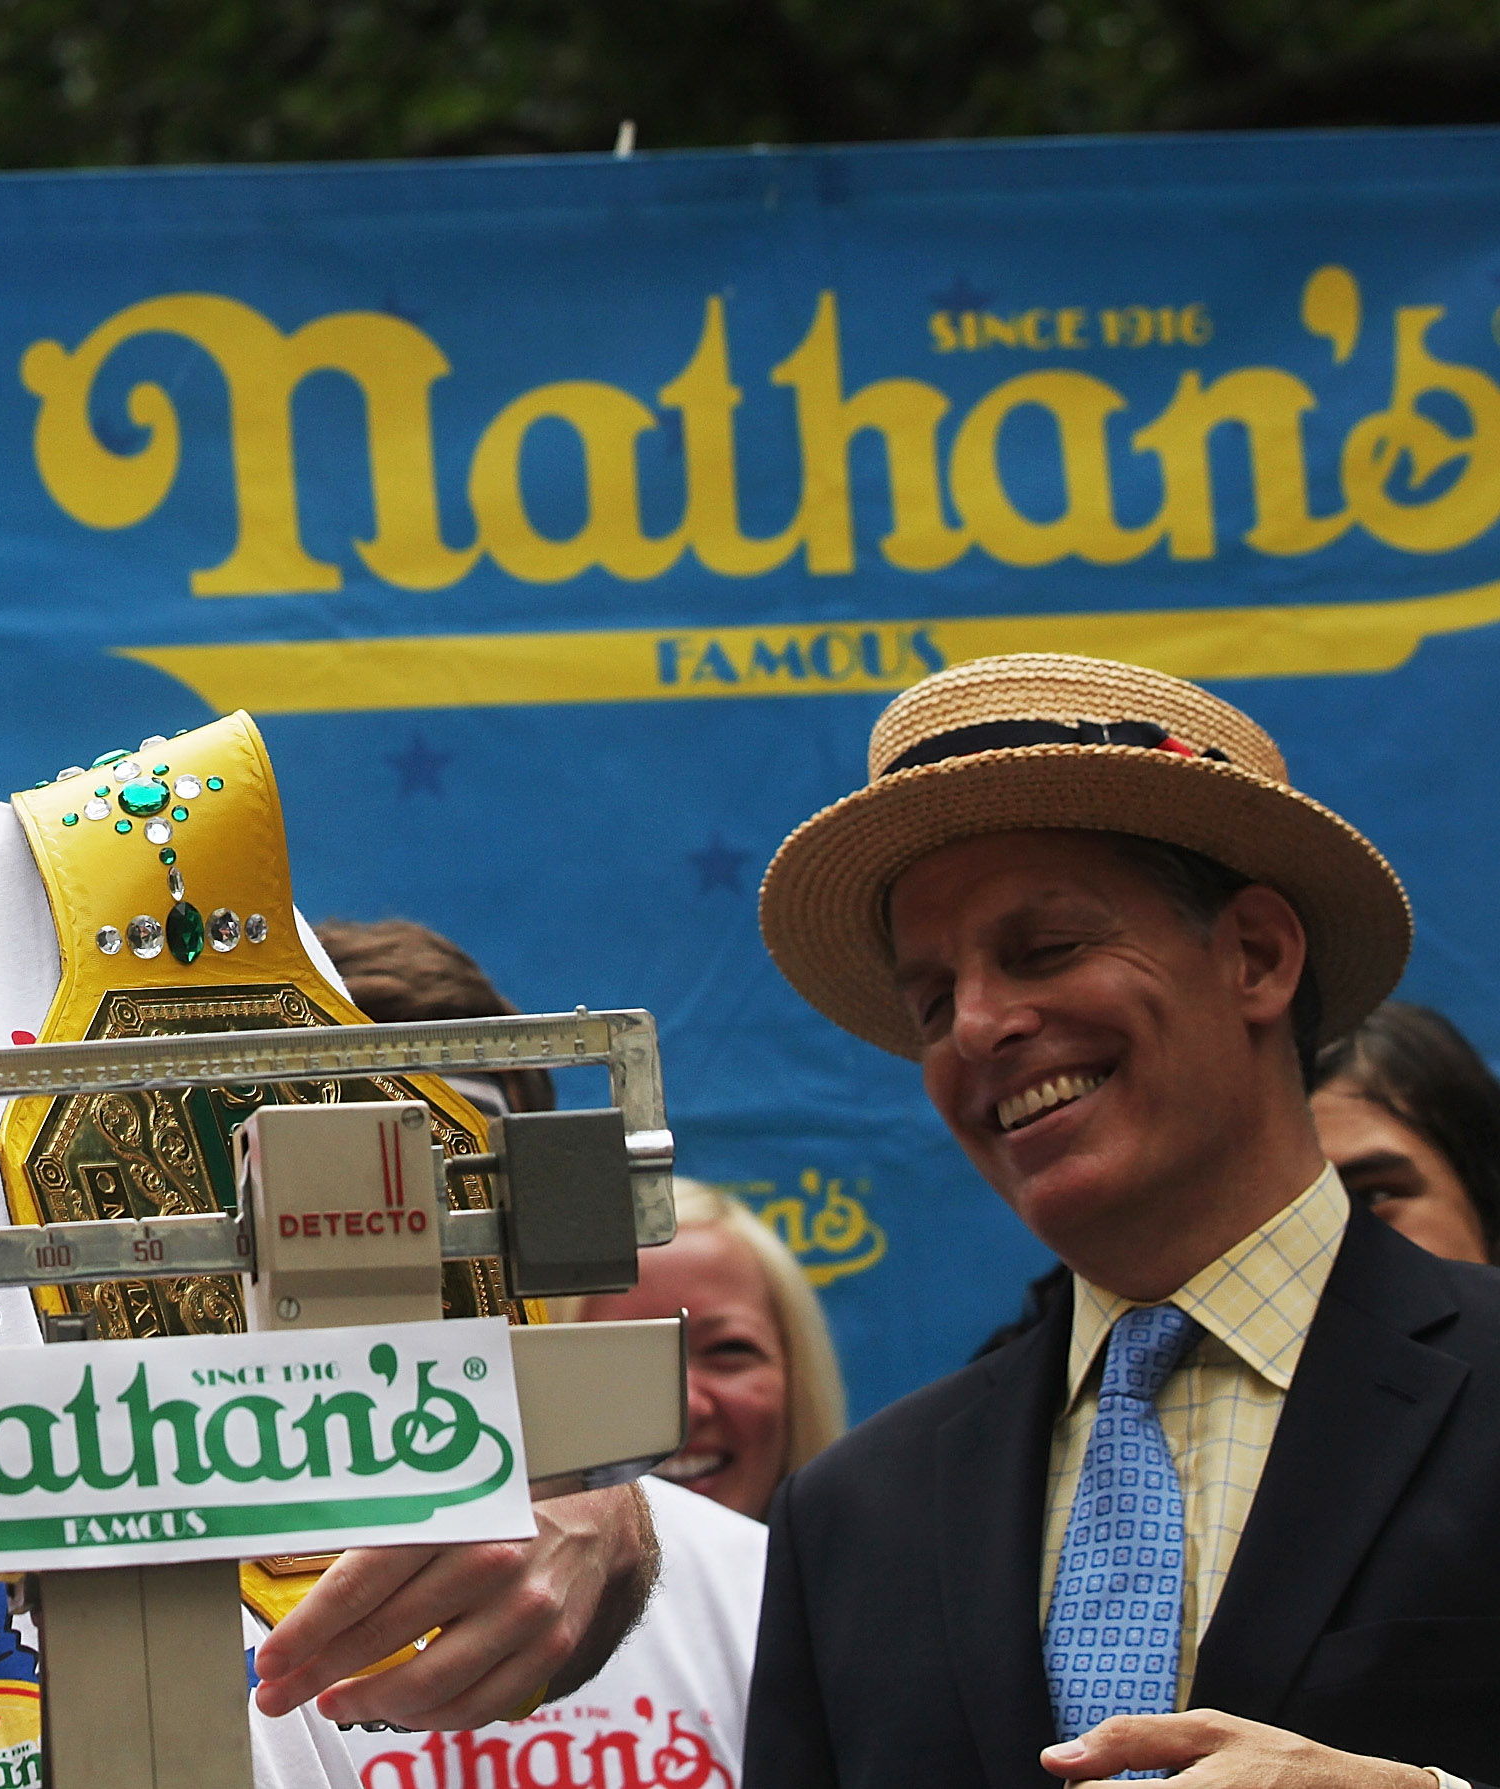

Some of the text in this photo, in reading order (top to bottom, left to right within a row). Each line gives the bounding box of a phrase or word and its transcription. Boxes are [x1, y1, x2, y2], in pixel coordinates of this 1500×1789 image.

[928, 302, 1213, 354] SINCE 1916
[19, 264, 1500, 595] Nathan's
[656, 622, 947, 686] FAMOUS
[279, 1209, 427, 1237] DETECTO
[36, 1246, 71, 1269] 100
[133, 1240, 164, 1262] 50
[236, 1233, 250, 1257] 0
[191, 1360, 342, 1387] SINCE 1916
[63, 1508, 208, 1545] FAMOUS
[360, 1695, 713, 1789] athan's
